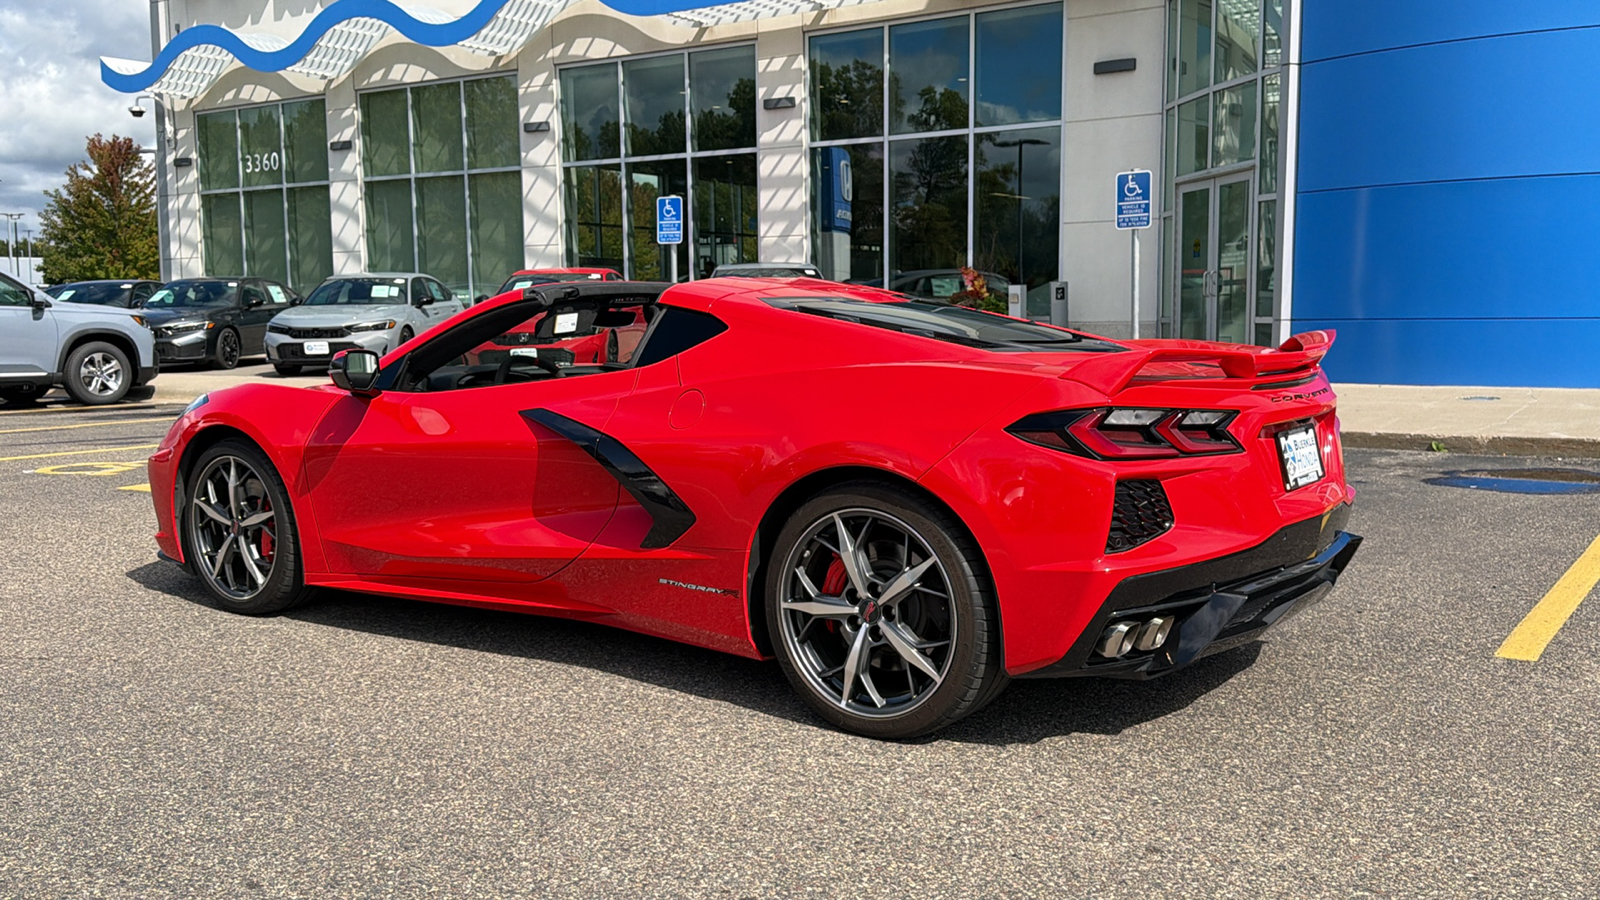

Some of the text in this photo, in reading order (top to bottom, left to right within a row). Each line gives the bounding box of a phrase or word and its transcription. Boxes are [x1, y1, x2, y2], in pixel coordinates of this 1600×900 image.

[245, 151, 279, 173] 3360
[1293, 437, 1315, 451] BUERKLE
[1296, 450, 1318, 470] HONDA
[659, 578, 724, 594] STINGRAY
